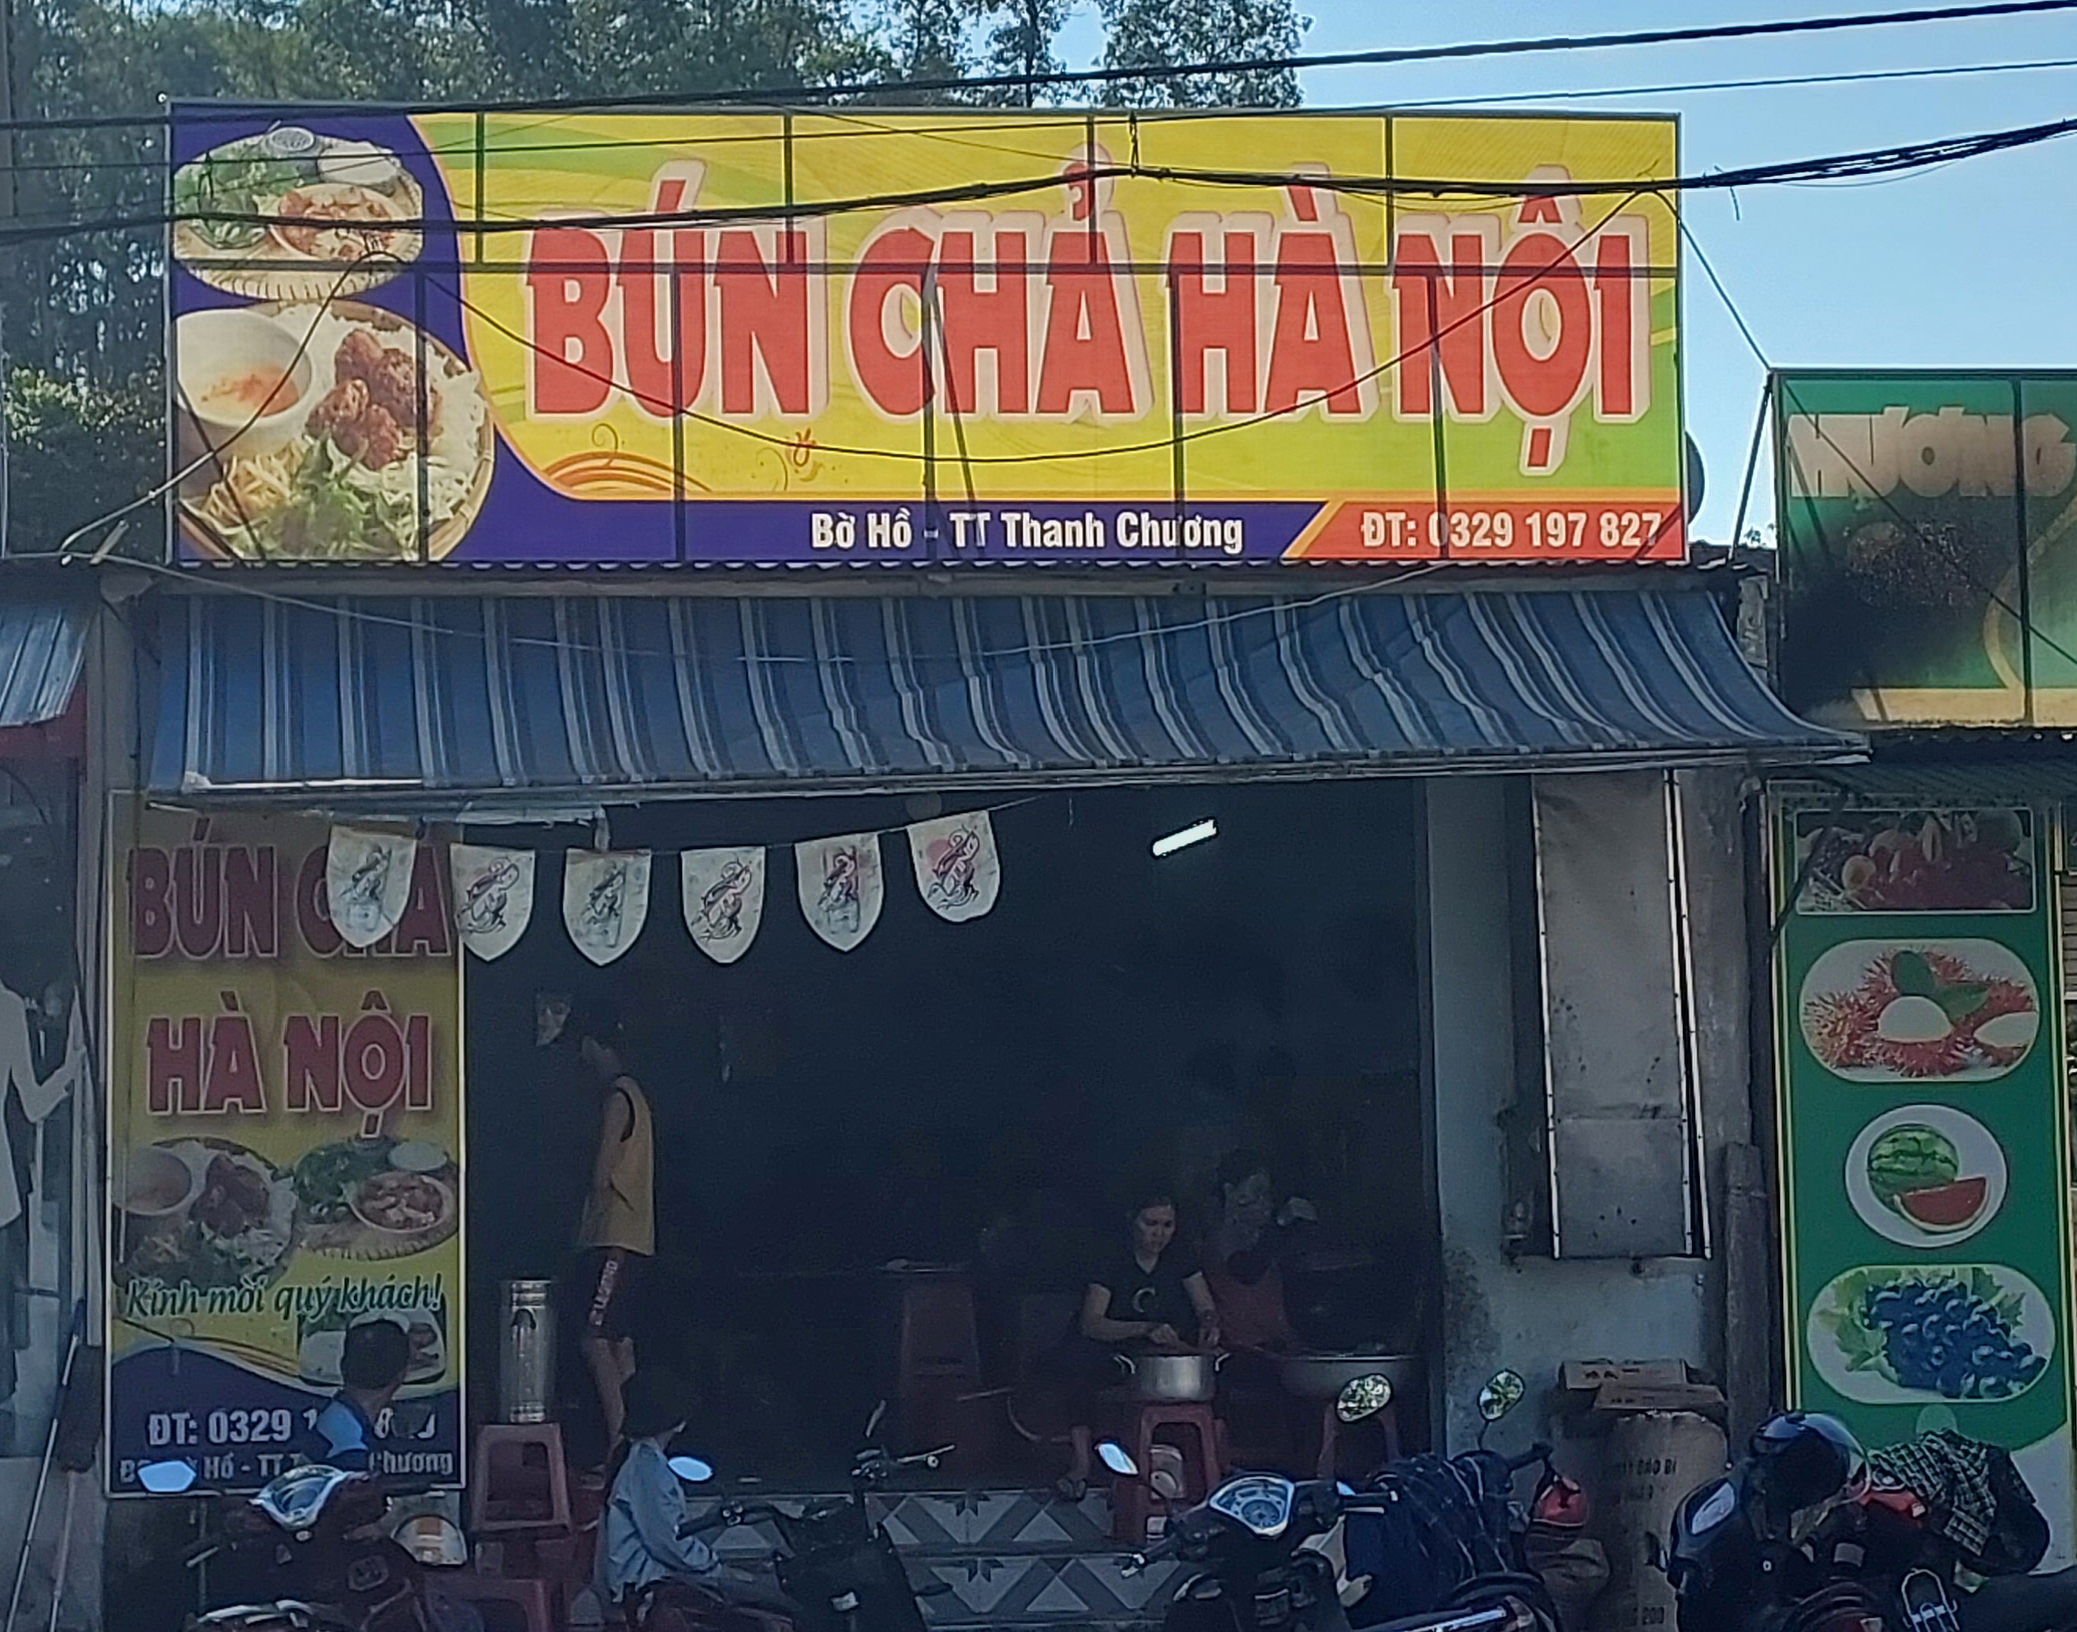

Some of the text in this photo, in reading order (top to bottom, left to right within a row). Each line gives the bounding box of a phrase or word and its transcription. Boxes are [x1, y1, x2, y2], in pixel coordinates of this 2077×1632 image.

[522, 152, 1642, 470] BÚN CHẢ HÀ NỘI
[811, 511, 856, 549] Bờ
[867, 508, 912, 549] Hồ
[950, 512, 990, 549] TT
[1001, 511, 1105, 549] Thanh
[1116, 511, 1244, 555] Chương
[1361, 511, 1663, 548] ĐT: 0329 197 827
[126, 816, 279, 959] BÚN
[146, 990, 433, 1138] HÀ NỘI
[127, 1272, 443, 1323] Kính mời quý khách!
[148, 1412, 198, 1446] ĐT:
[208, 1409, 292, 1444] 0329
